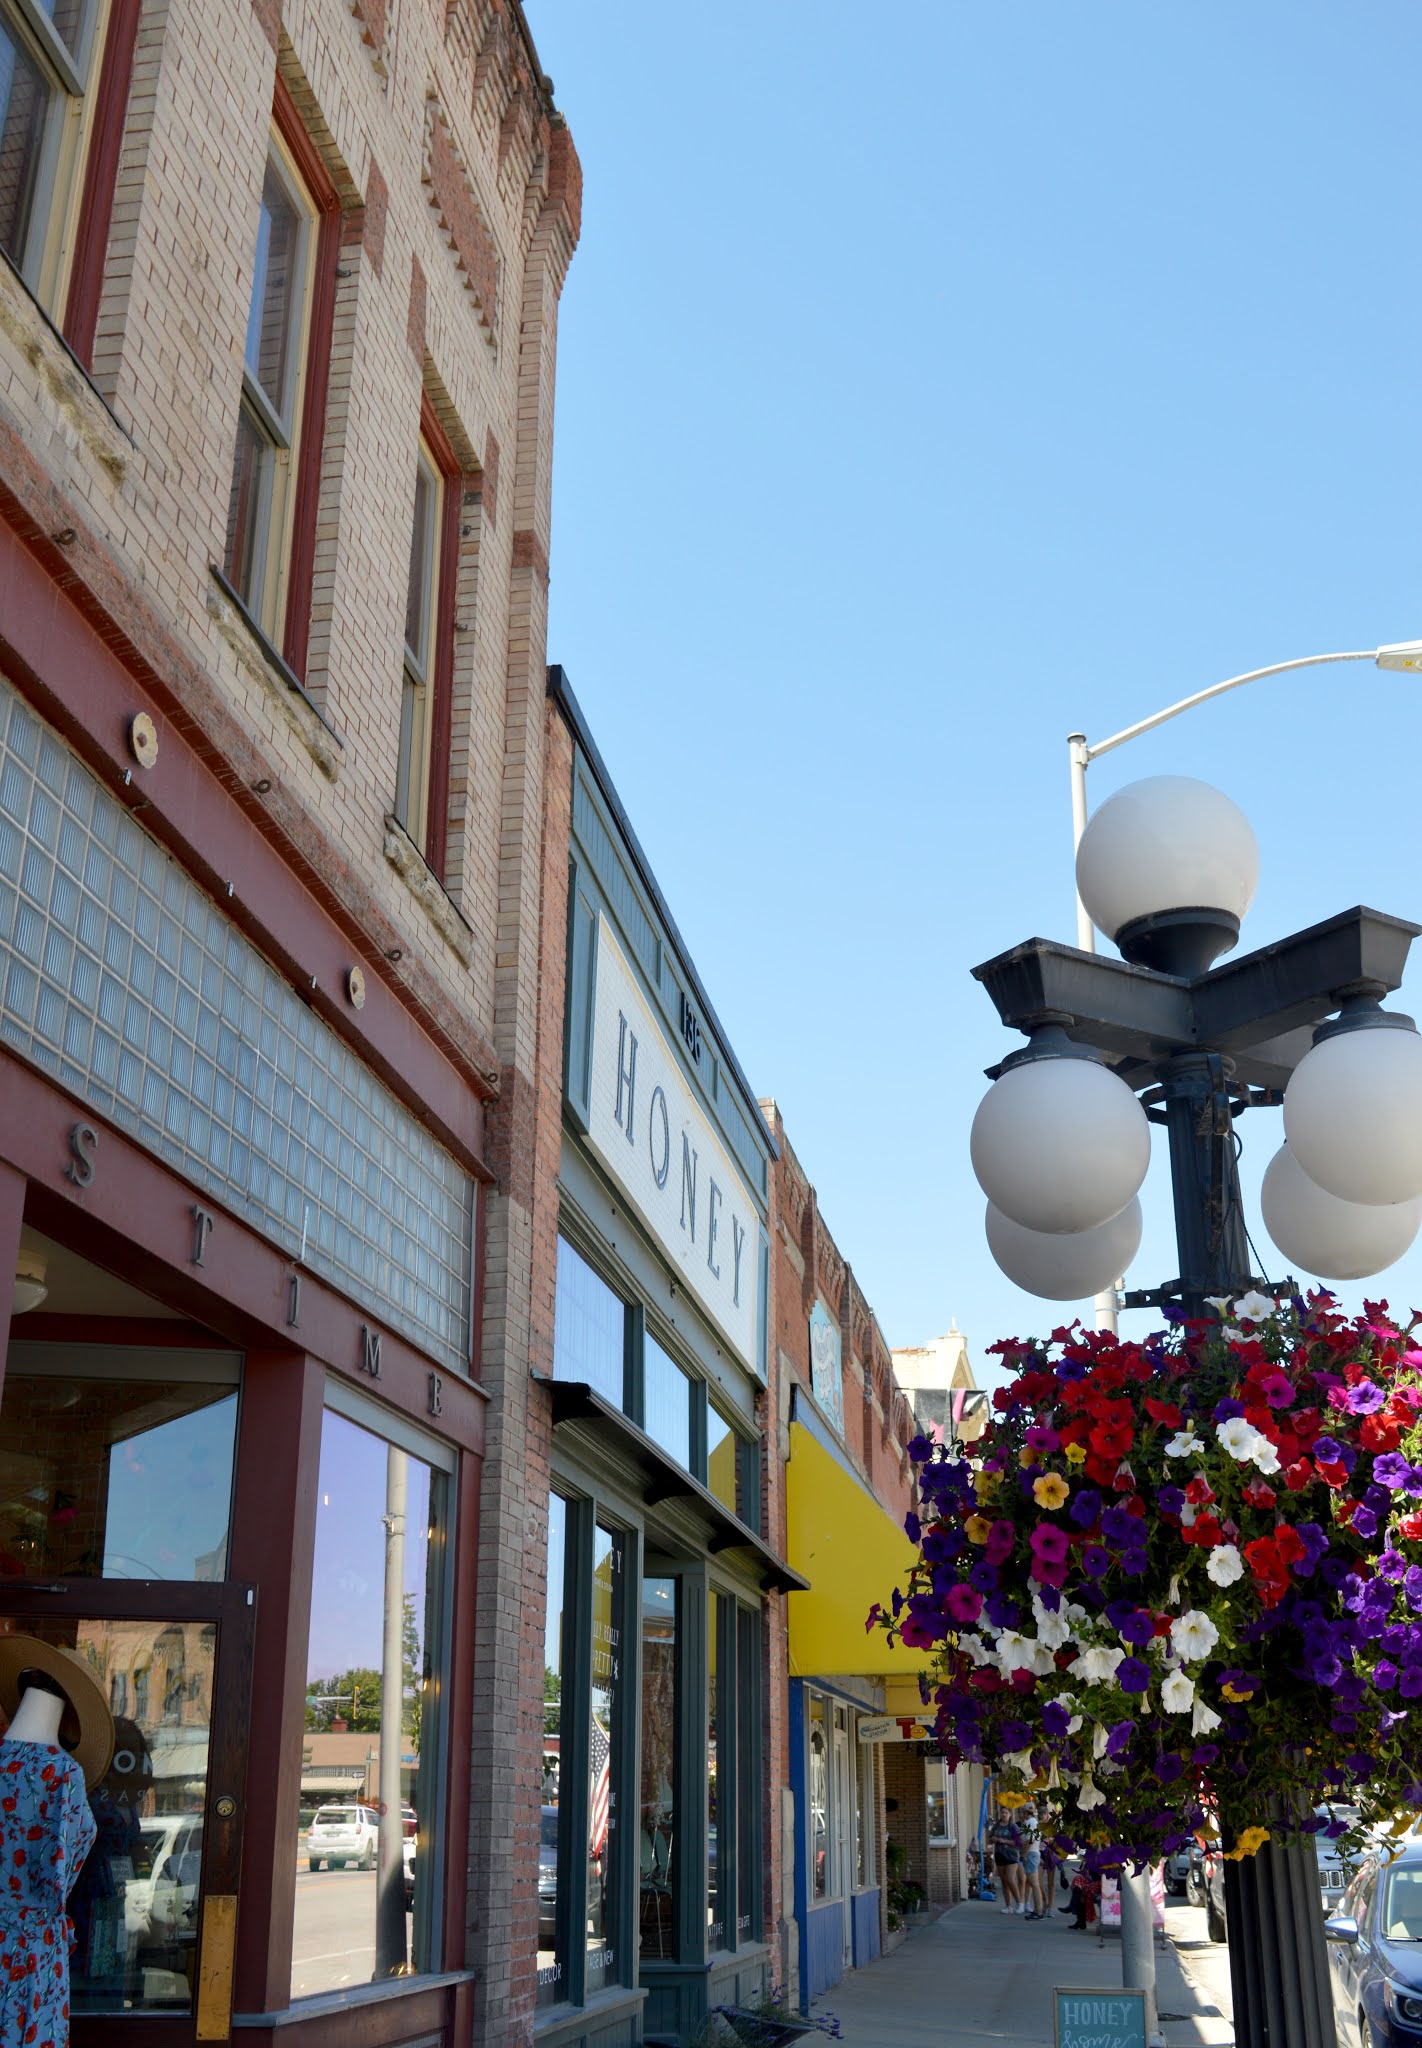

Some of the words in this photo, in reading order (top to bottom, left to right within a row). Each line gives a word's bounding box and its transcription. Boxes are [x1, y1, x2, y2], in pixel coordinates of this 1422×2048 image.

[614, 1009, 746, 1309] HONEY
[539, 1962, 562, 1985] DECOR
[1063, 2002, 1133, 2026] HONEY
